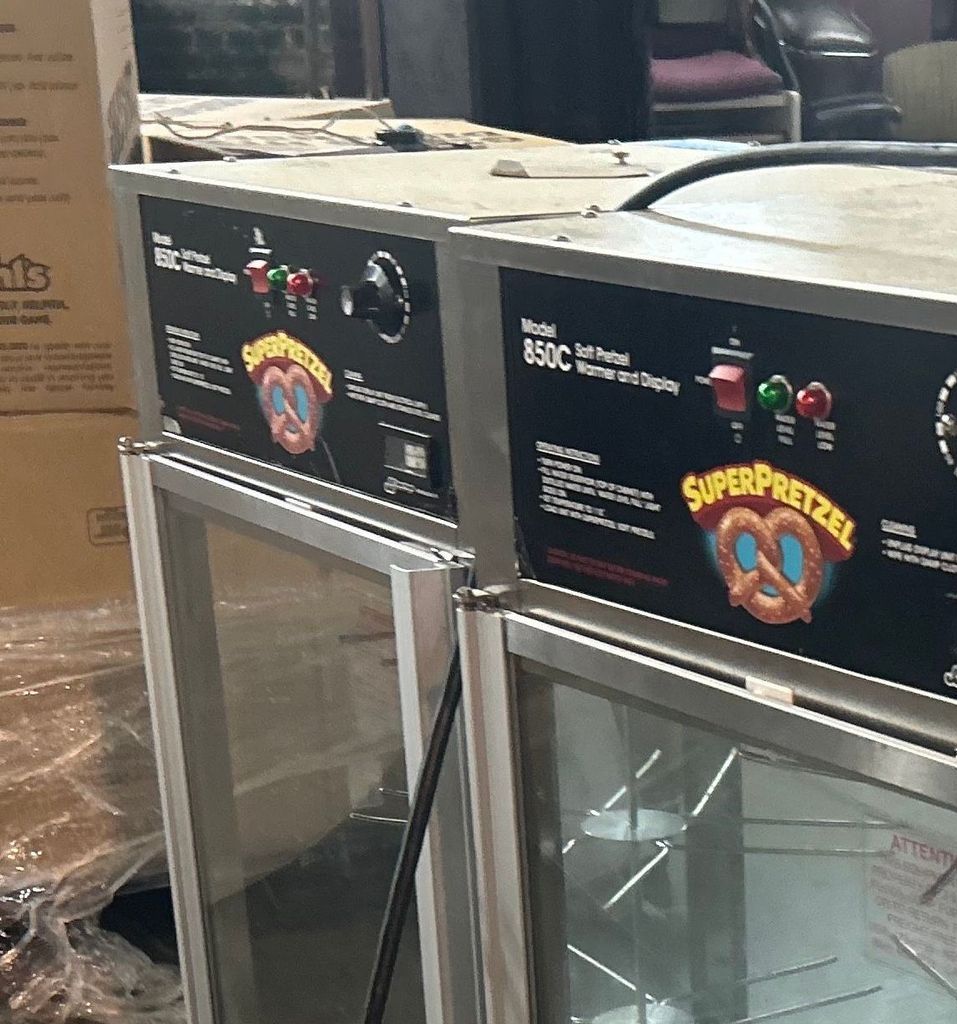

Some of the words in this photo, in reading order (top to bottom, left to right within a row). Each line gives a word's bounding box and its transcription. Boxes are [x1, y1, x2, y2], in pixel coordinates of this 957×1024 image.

[521, 317, 557, 338] Model
[523, 337, 572, 372] 850C
[596, 346, 630, 367] Pretzel
[575, 359, 617, 381] Warmer
[617, 370, 640, 386] and
[639, 371, 681, 396] Display
[682, 463, 856, 551] SUPERPRETZEL
